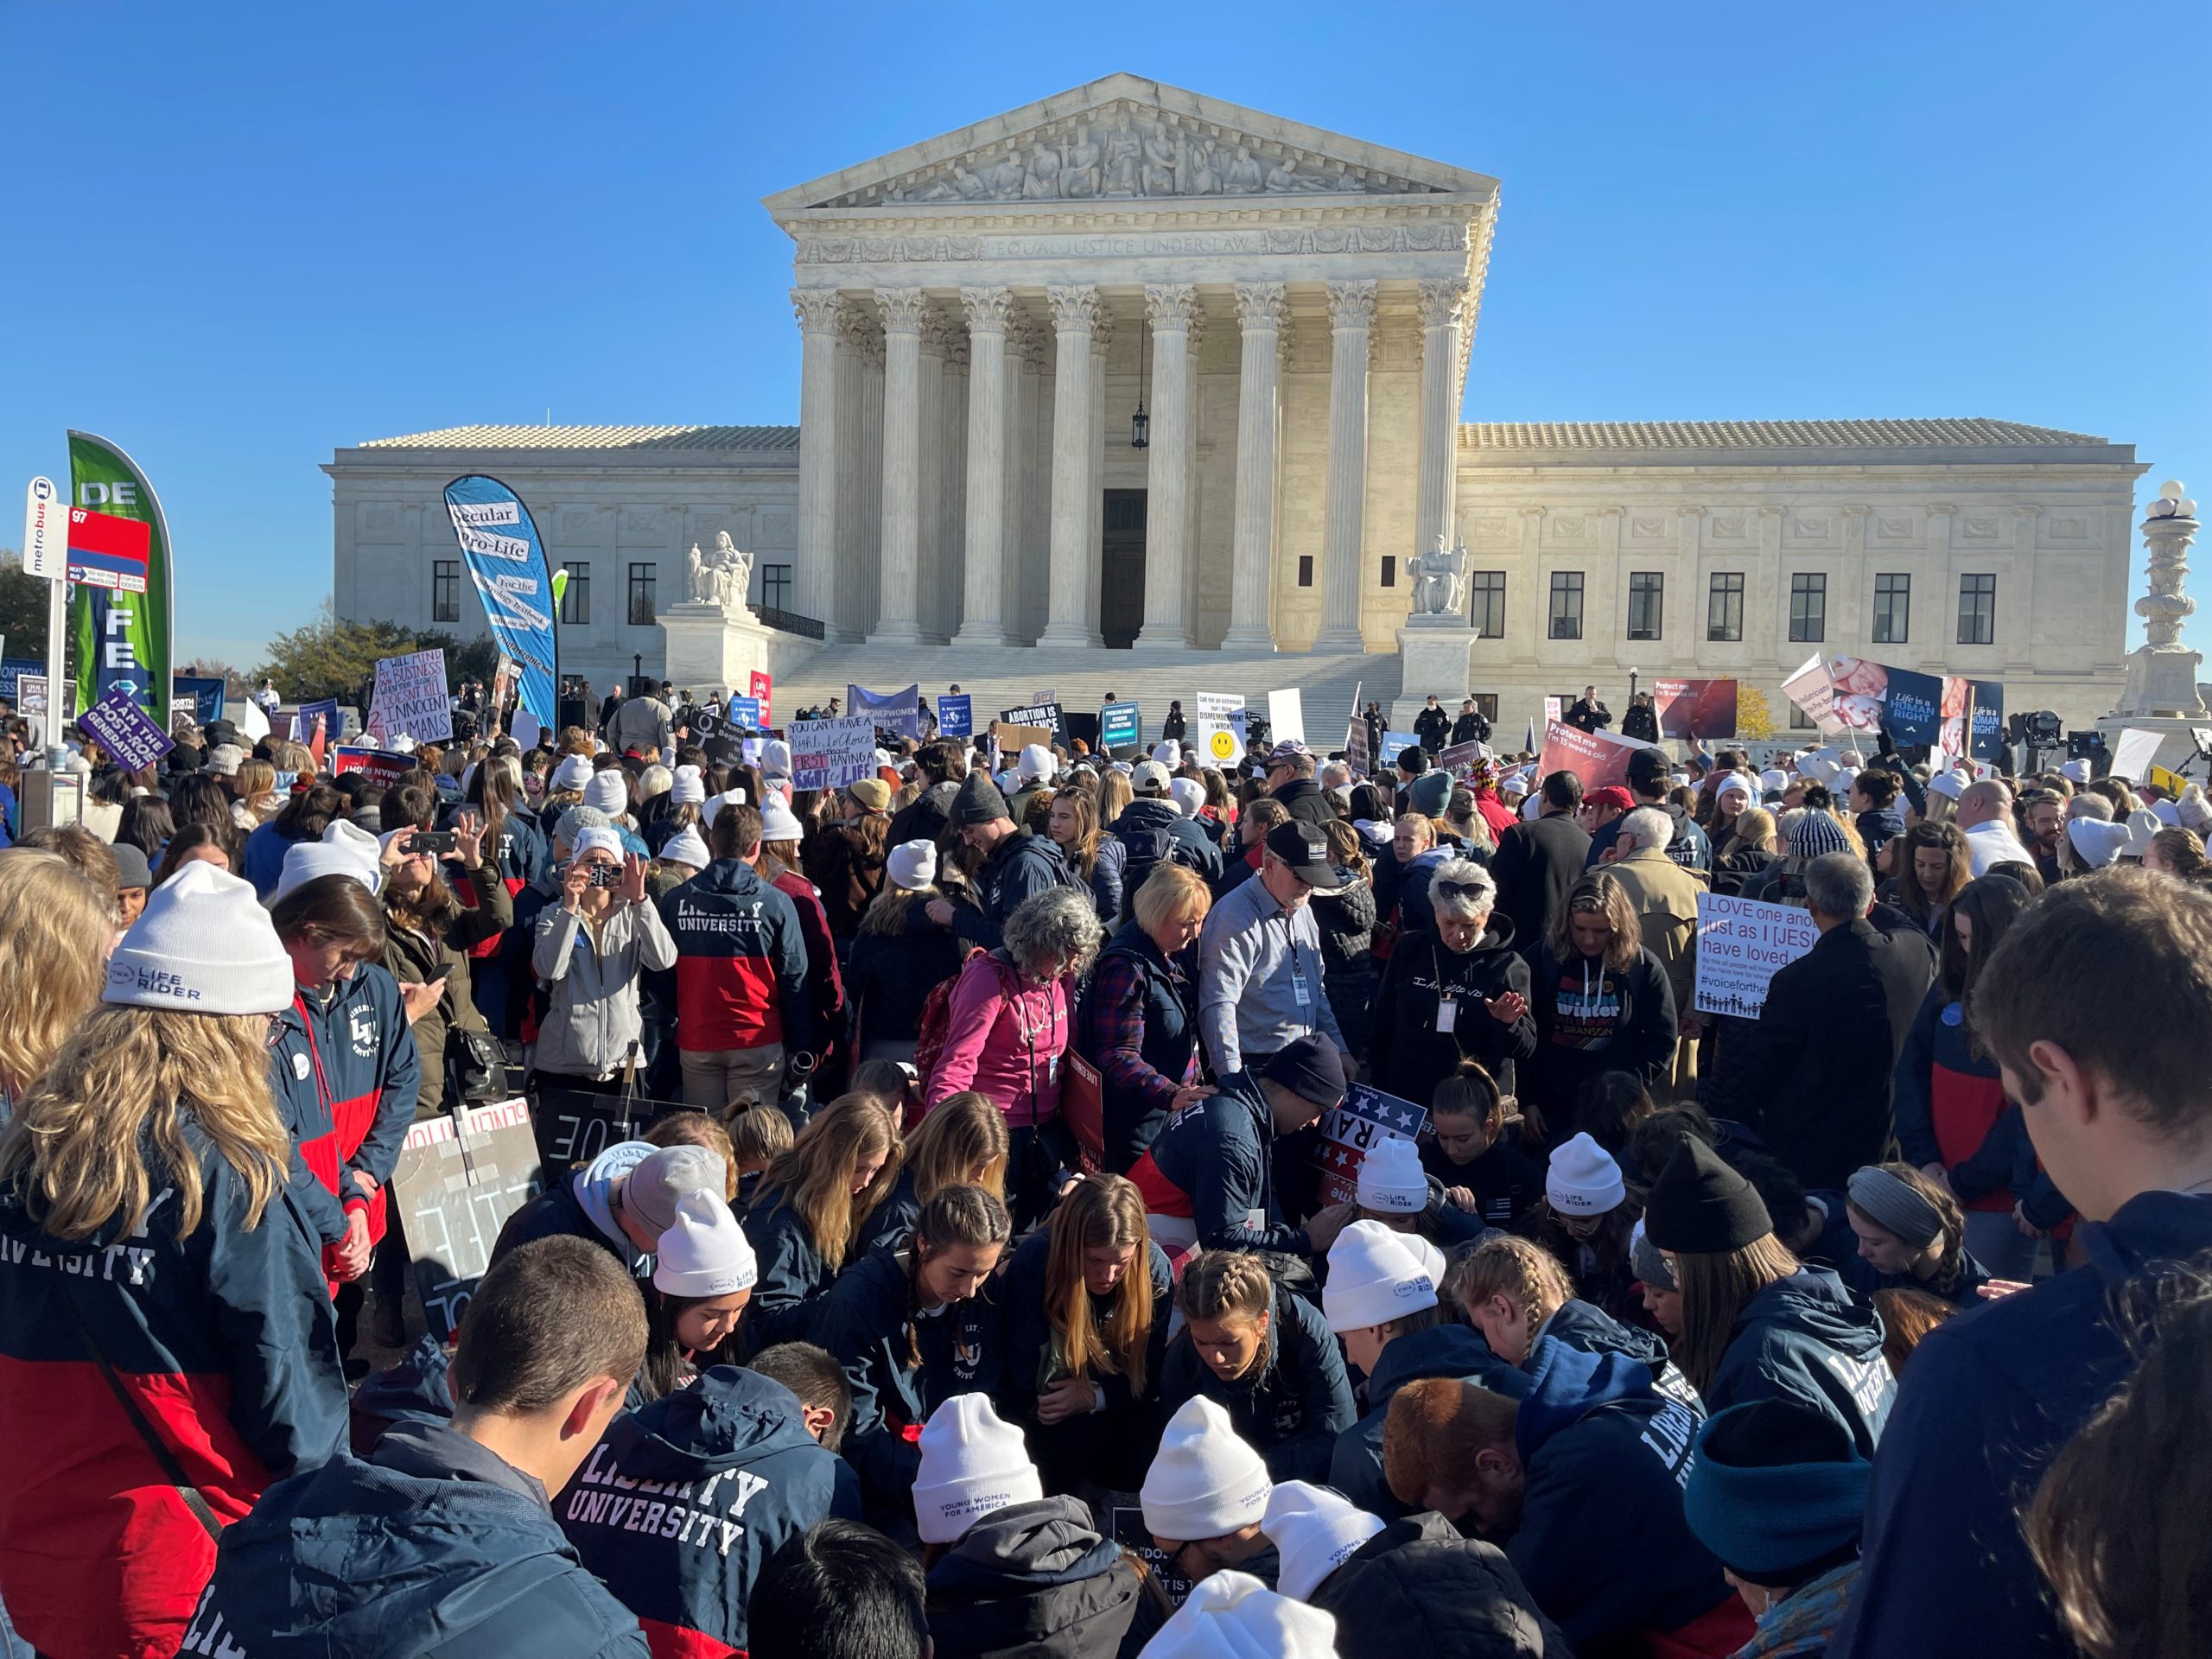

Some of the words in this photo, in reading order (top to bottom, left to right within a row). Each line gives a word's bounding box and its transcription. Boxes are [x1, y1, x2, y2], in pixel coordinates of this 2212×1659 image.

[996, 241, 1058, 256] EQUAL
[1064, 239, 1134, 255] JUSTICE
[1143, 238, 1204, 253] UNDER
[1211, 238, 1249, 251] LAW
[72, 510, 87, 524] 97
[453, 508, 512, 523] Secular
[34, 503, 46, 571] metrobus
[461, 531, 525, 557] Pro-Life
[378, 661, 385, 672] I
[390, 656, 410, 668] WILL
[412, 650, 442, 664] MIND
[392, 660, 442, 683] BUSINESS
[380, 684, 397, 696] WHEN
[423, 681, 442, 696] KILL
[1656, 681, 1679, 691] Protect
[1896, 692, 1914, 704] Life
[1915, 696, 1923, 705] is
[383, 693, 447, 723] INNOCENT
[1008, 707, 1046, 723] ABORTION
[1046, 705, 1057, 718] IS
[1890, 700, 1936, 716] HUMAN
[1974, 706, 1986, 717] Life
[110, 696, 119, 705] I
[118, 706, 139, 727] AM
[140, 726, 164, 753] THE
[1199, 712, 1243, 722] DISMEMBERMENT
[1893, 710, 1931, 723] RIGHT
[1971, 715, 1999, 726] HUMAN
[96, 701, 158, 762] POST-ROE
[385, 713, 449, 744] HUMANS
[723, 721, 745, 734] Peace
[789, 723, 810, 734] YOU
[810, 721, 834, 732] CAN'T
[839, 718, 862, 729] HAVE
[863, 717, 872, 727] A
[1972, 724, 1996, 735] RIGHT
[87, 711, 145, 771] GENERATION
[718, 729, 742, 744] Begins
[1550, 722, 1582, 743] Protect
[1582, 737, 1598, 749] me
[815, 747, 850, 757] without
[1548, 732, 1559, 742] I'm
[1560, 736, 1569, 746] 15
[1568, 741, 1592, 756] weeks
[1592, 751, 1607, 761] old
[728, 752, 737, 761] the
[793, 755, 828, 770] FIRST
[830, 753, 866, 767] HAVING
[865, 752, 874, 763] A
[374, 767, 401, 779] UMAN
[792, 768, 830, 789] RIGHT
[841, 763, 872, 786] LIFE
[1757, 908, 1783, 923] one
[677, 917, 762, 933] UNIVERSITY
[1704, 916, 1733, 936] just
[1738, 925, 1757, 939] as
[1764, 925, 1768, 942] I
[1702, 937, 1741, 958] have
[1747, 944, 1789, 966] loved
[1702, 957, 1710, 965] By
[1729, 961, 1748, 970] people
[138, 966, 182, 986] LIFE
[1413, 976, 1427, 987] I
[137, 977, 201, 1001] RIDER
[1563, 1026, 1613, 1036] BRANSON
[1565, 1194, 1584, 1203] LIFE
[1565, 1198, 1592, 1207] RIDER
[737, 1268, 753, 1281] LIFE
[939, 1498, 970, 1512] YOUNG
[974, 1492, 1012, 1504] WOMEN
[1240, 1486, 1265, 1505] YOUNG
[1245, 1494, 1262, 1510] FOR
[944, 1509, 961, 1519] FOR
[965, 1500, 1008, 1515] AMERICA
[567, 1489, 745, 1557] UNIVERSITY
[1327, 1538, 1363, 1562] YOUNG
[1173, 1580, 1185, 1591] IS
